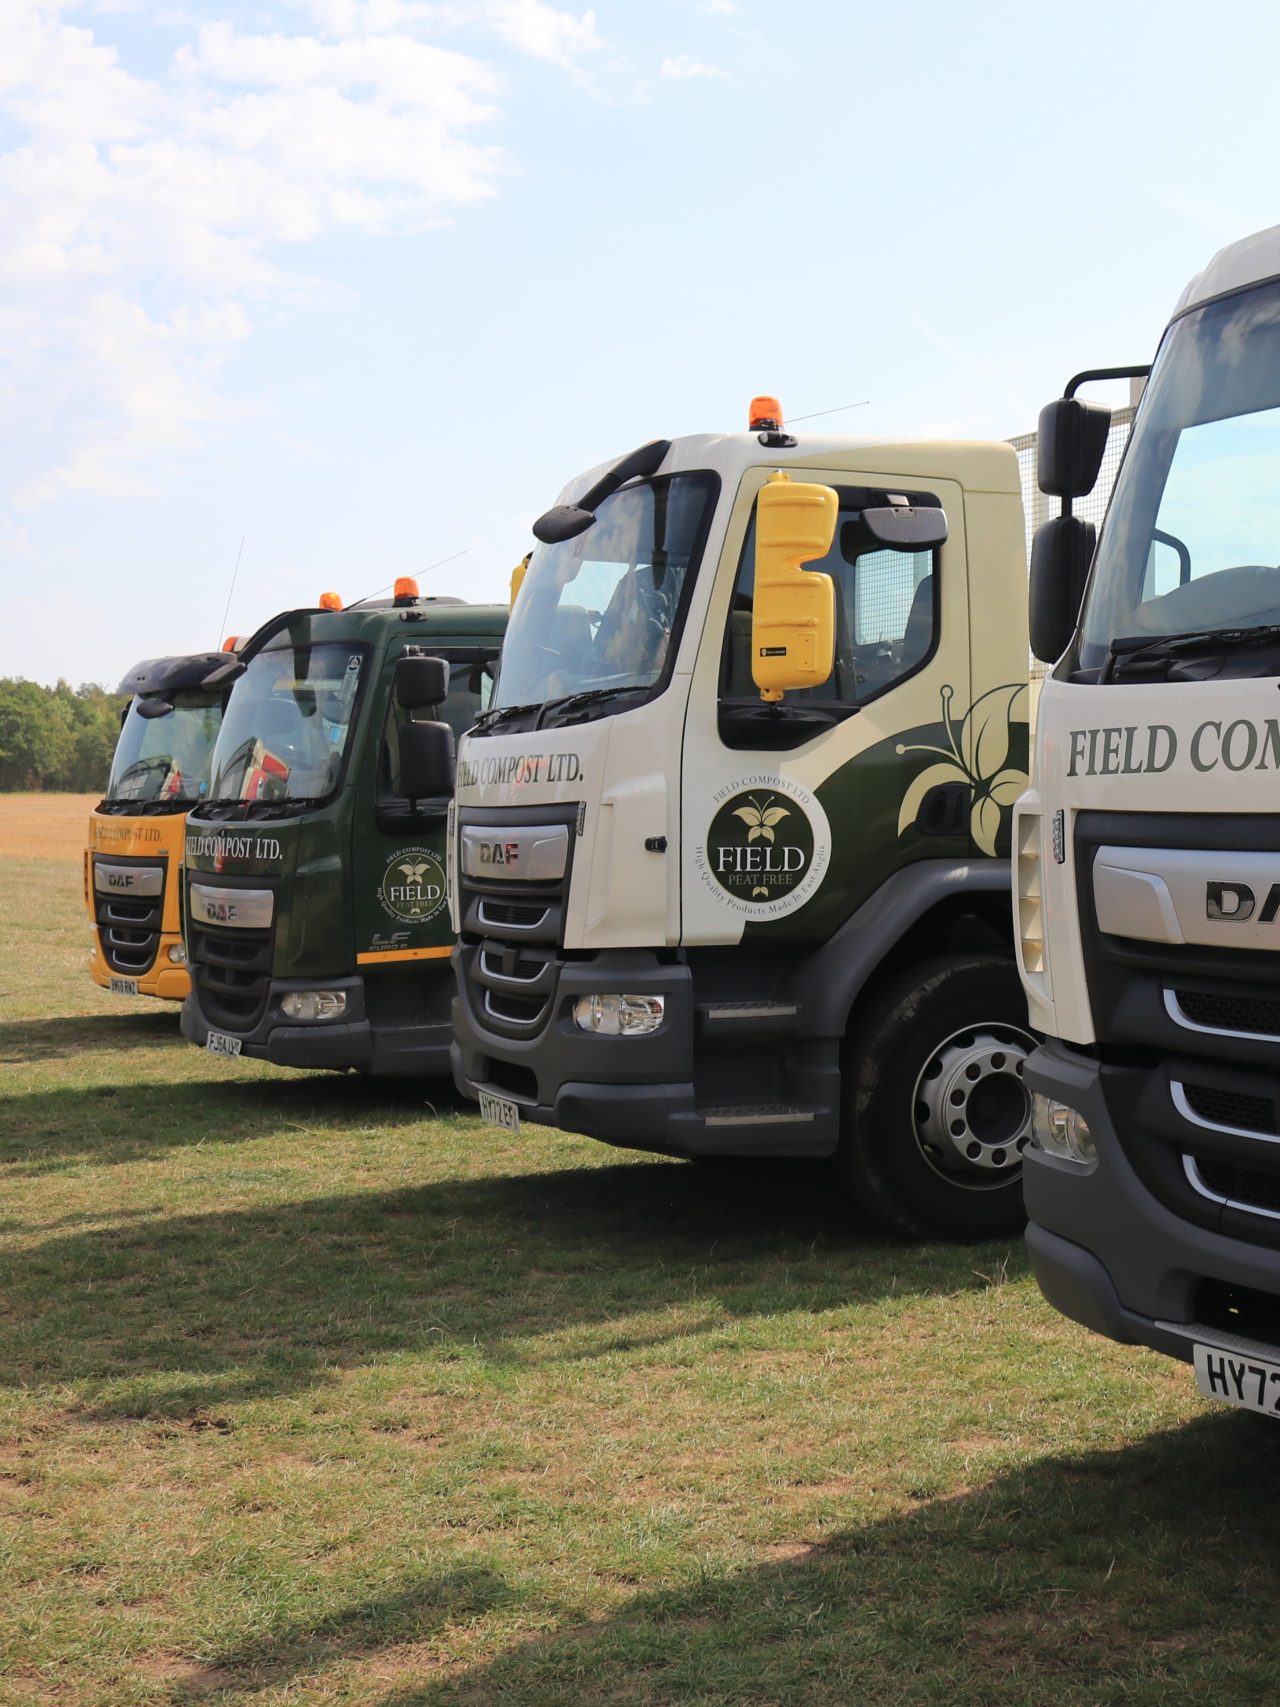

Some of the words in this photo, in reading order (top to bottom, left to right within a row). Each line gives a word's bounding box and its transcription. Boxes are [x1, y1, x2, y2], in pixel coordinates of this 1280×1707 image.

[1066, 724, 1178, 777] FIELD
[481, 755, 544, 785] COMPOST
[546, 753, 584, 782] LTD.
[713, 782, 739, 803] FIELD
[741, 775, 793, 791] COMPOST
[793, 786, 811, 805] LTD
[204, 836, 253, 858] COMPOST
[255, 838, 283, 860] LTD.
[386, 850, 401, 864] FIELD
[402, 846, 431, 855] COMPOST
[430, 850, 442, 862] LTD
[480, 841, 519, 865] DAF
[716, 846, 805, 872] FIELD
[108, 874, 134, 888] DAF
[695, 846, 704, 870] High
[701, 871, 725, 903] Quality
[726, 898, 766, 915] Products
[768, 900, 792, 913] Made
[792, 893, 802, 901] In
[801, 877, 816, 892] East
[813, 844, 825, 874] Anglia
[728, 874, 760, 886] PEAT
[763, 873, 793, 885] FREE
[390, 885, 440, 901] FIELD
[206, 902, 238, 921] DAF
[481, 1095, 504, 1124] HY72
